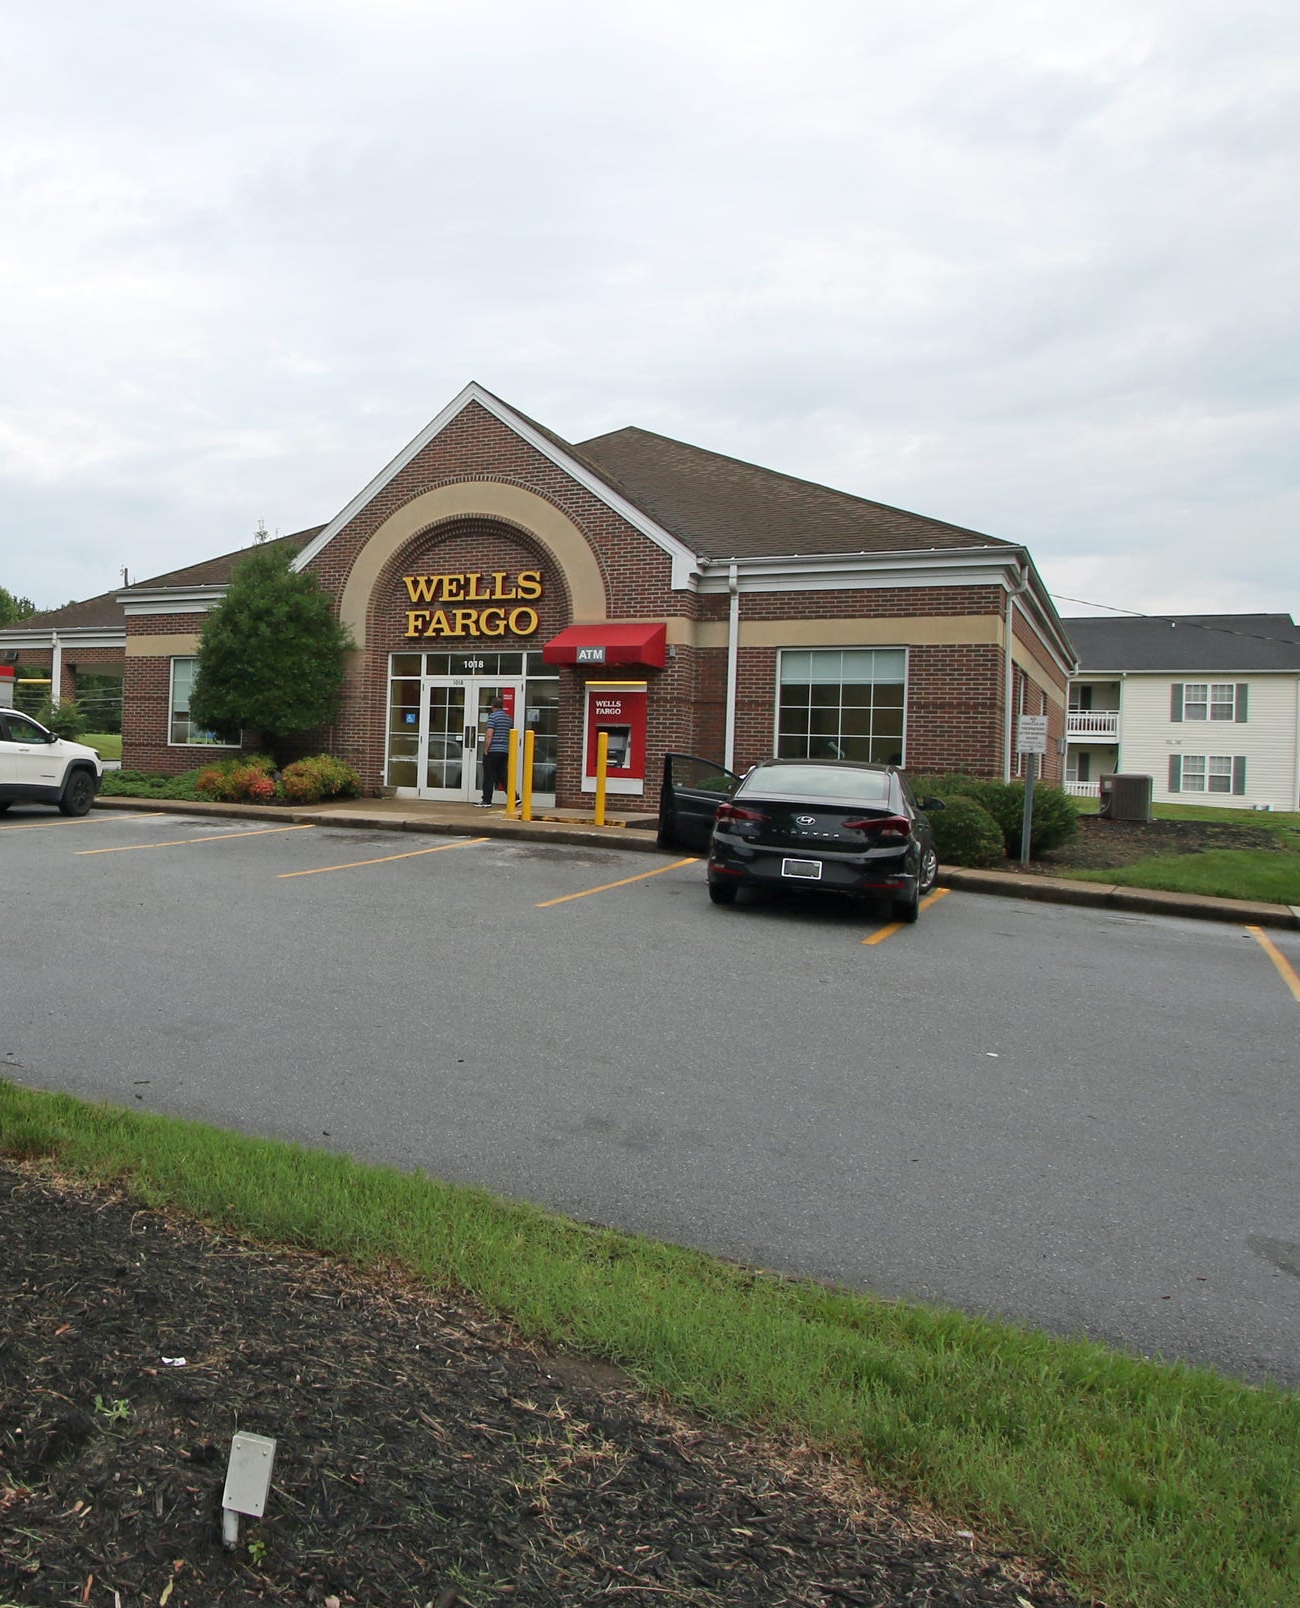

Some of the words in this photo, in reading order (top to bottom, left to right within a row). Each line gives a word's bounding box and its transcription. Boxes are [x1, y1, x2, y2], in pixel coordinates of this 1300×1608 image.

[402, 570, 542, 603] WELLS
[404, 606, 539, 637] FARGO
[463, 660, 484, 669] 1018
[578, 649, 604, 660] ATM
